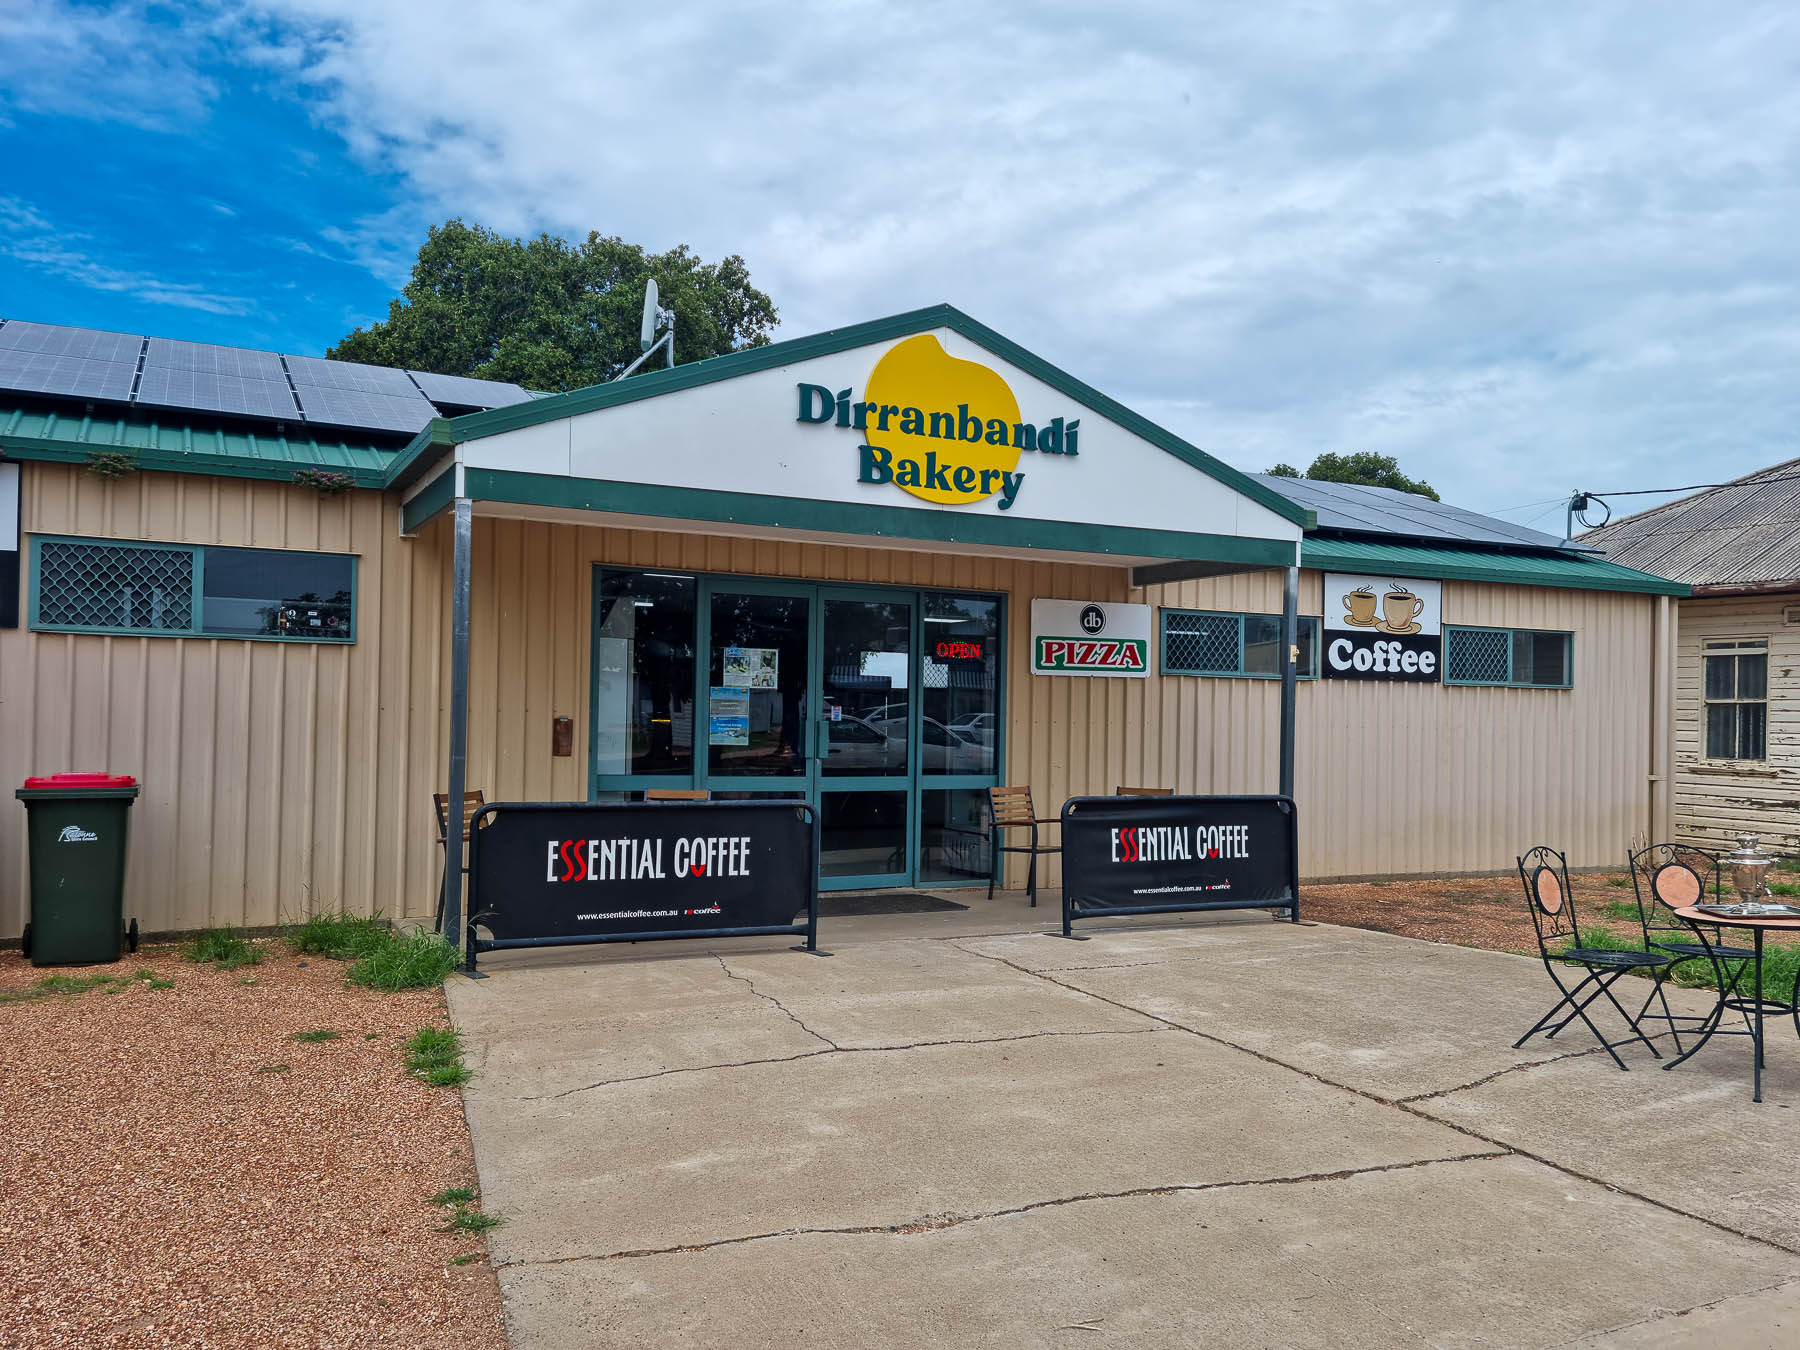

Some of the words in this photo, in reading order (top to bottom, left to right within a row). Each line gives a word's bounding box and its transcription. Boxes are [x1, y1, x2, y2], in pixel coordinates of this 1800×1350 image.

[797, 383, 1080, 455] Dirranbandi
[857, 444, 1026, 511] Bakery
[1083, 612, 1102, 628] db
[936, 643, 981, 658] OPEN
[1041, 640, 1143, 668] PIZZA
[1328, 638, 1436, 674] Coffee
[547, 839, 665, 882] ESSENTIAL
[674, 836, 750, 877] COFFEE
[1112, 827, 1191, 862] ESSENTIAL
[1196, 825, 1249, 859] COFFEE
[577, 909, 678, 920] www.essentialcoffee.com.au
